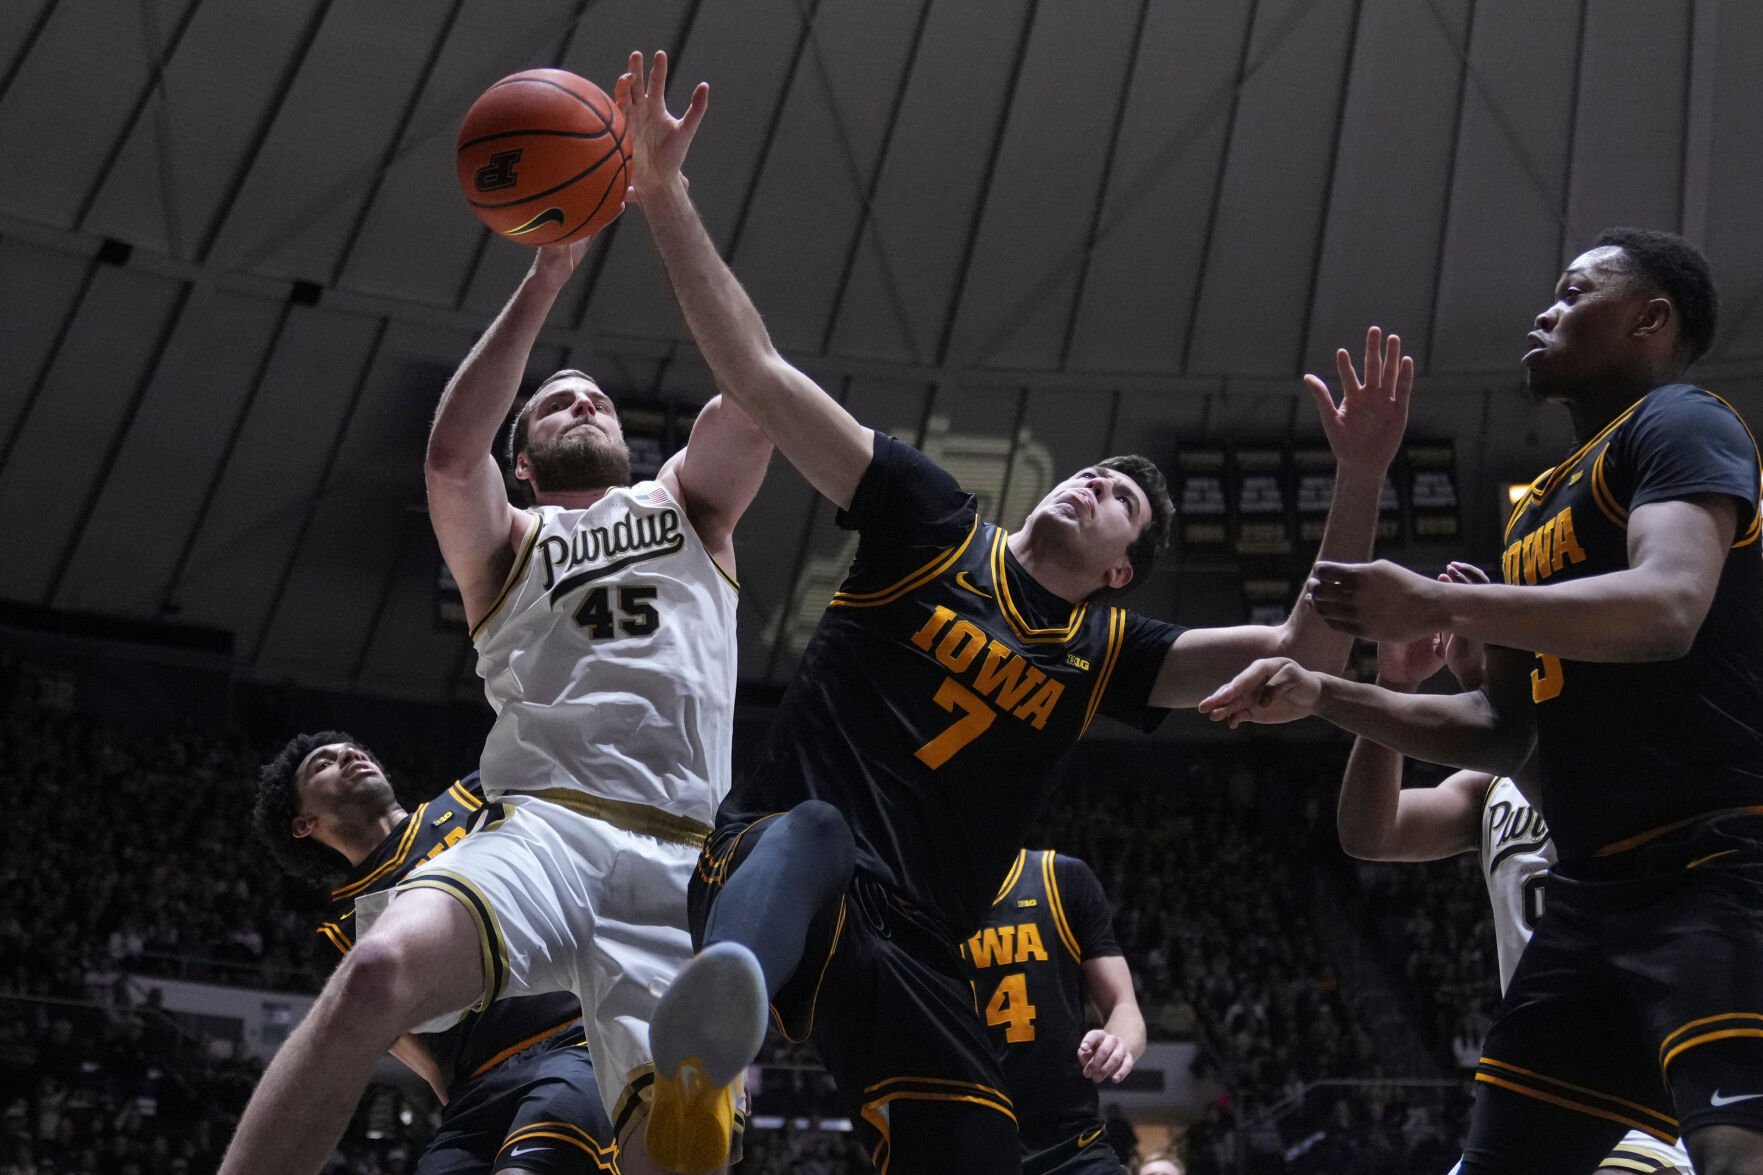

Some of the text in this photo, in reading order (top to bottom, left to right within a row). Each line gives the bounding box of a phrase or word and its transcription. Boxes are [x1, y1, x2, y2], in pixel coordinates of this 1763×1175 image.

[475, 148, 522, 192] P
[537, 508, 684, 594] Purdue
[572, 585, 661, 640] 45
[911, 604, 1066, 731] IOWA
[913, 676, 998, 770] 7
[960, 923, 1049, 969] WA
[970, 972, 1037, 1044] 4
